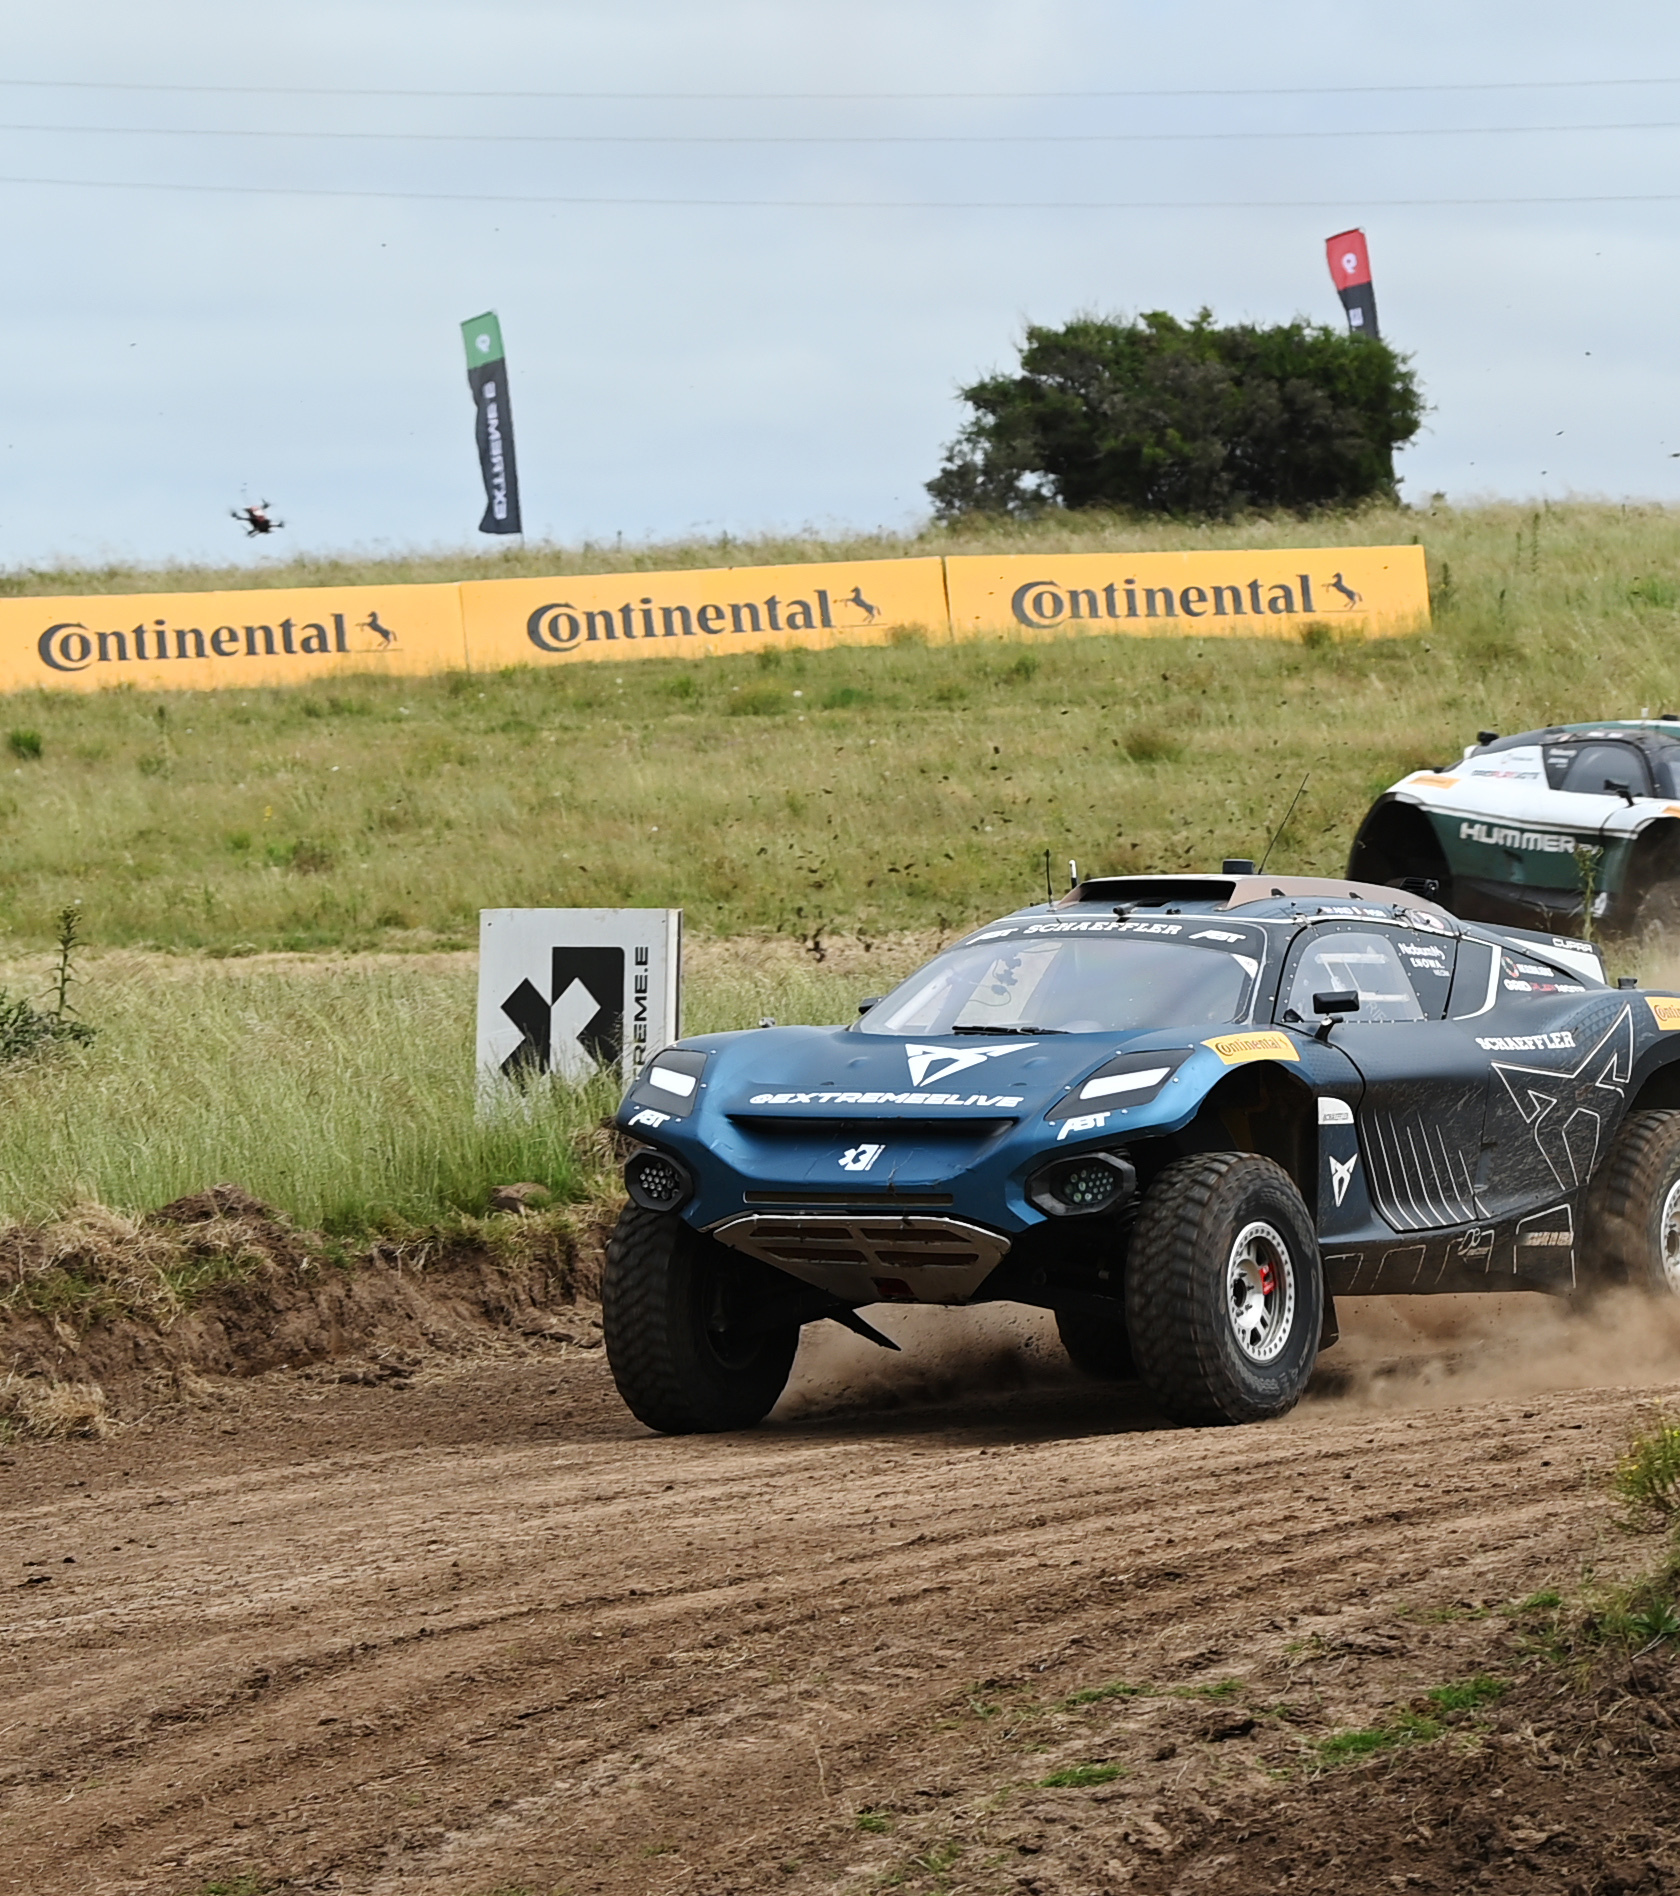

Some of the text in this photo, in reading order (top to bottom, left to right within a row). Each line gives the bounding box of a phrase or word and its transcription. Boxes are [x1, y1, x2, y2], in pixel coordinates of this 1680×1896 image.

[1011, 573, 1317, 629] Continental
[526, 588, 836, 653] Continental
[37, 612, 351, 672] Continental
[1459, 821, 1576, 854] HUMMER
[1022, 921, 1183, 936] SCHAEFFLER
[1188, 929, 1247, 944] ABT
[1214, 1036, 1282, 1057] Continental
[1474, 1031, 1577, 1051] SCHAEFFLER
[749, 1091, 1025, 1108] @EXTREMEELIVE
[627, 1108, 671, 1129] ABT
[1056, 1111, 1111, 1141] ABT
